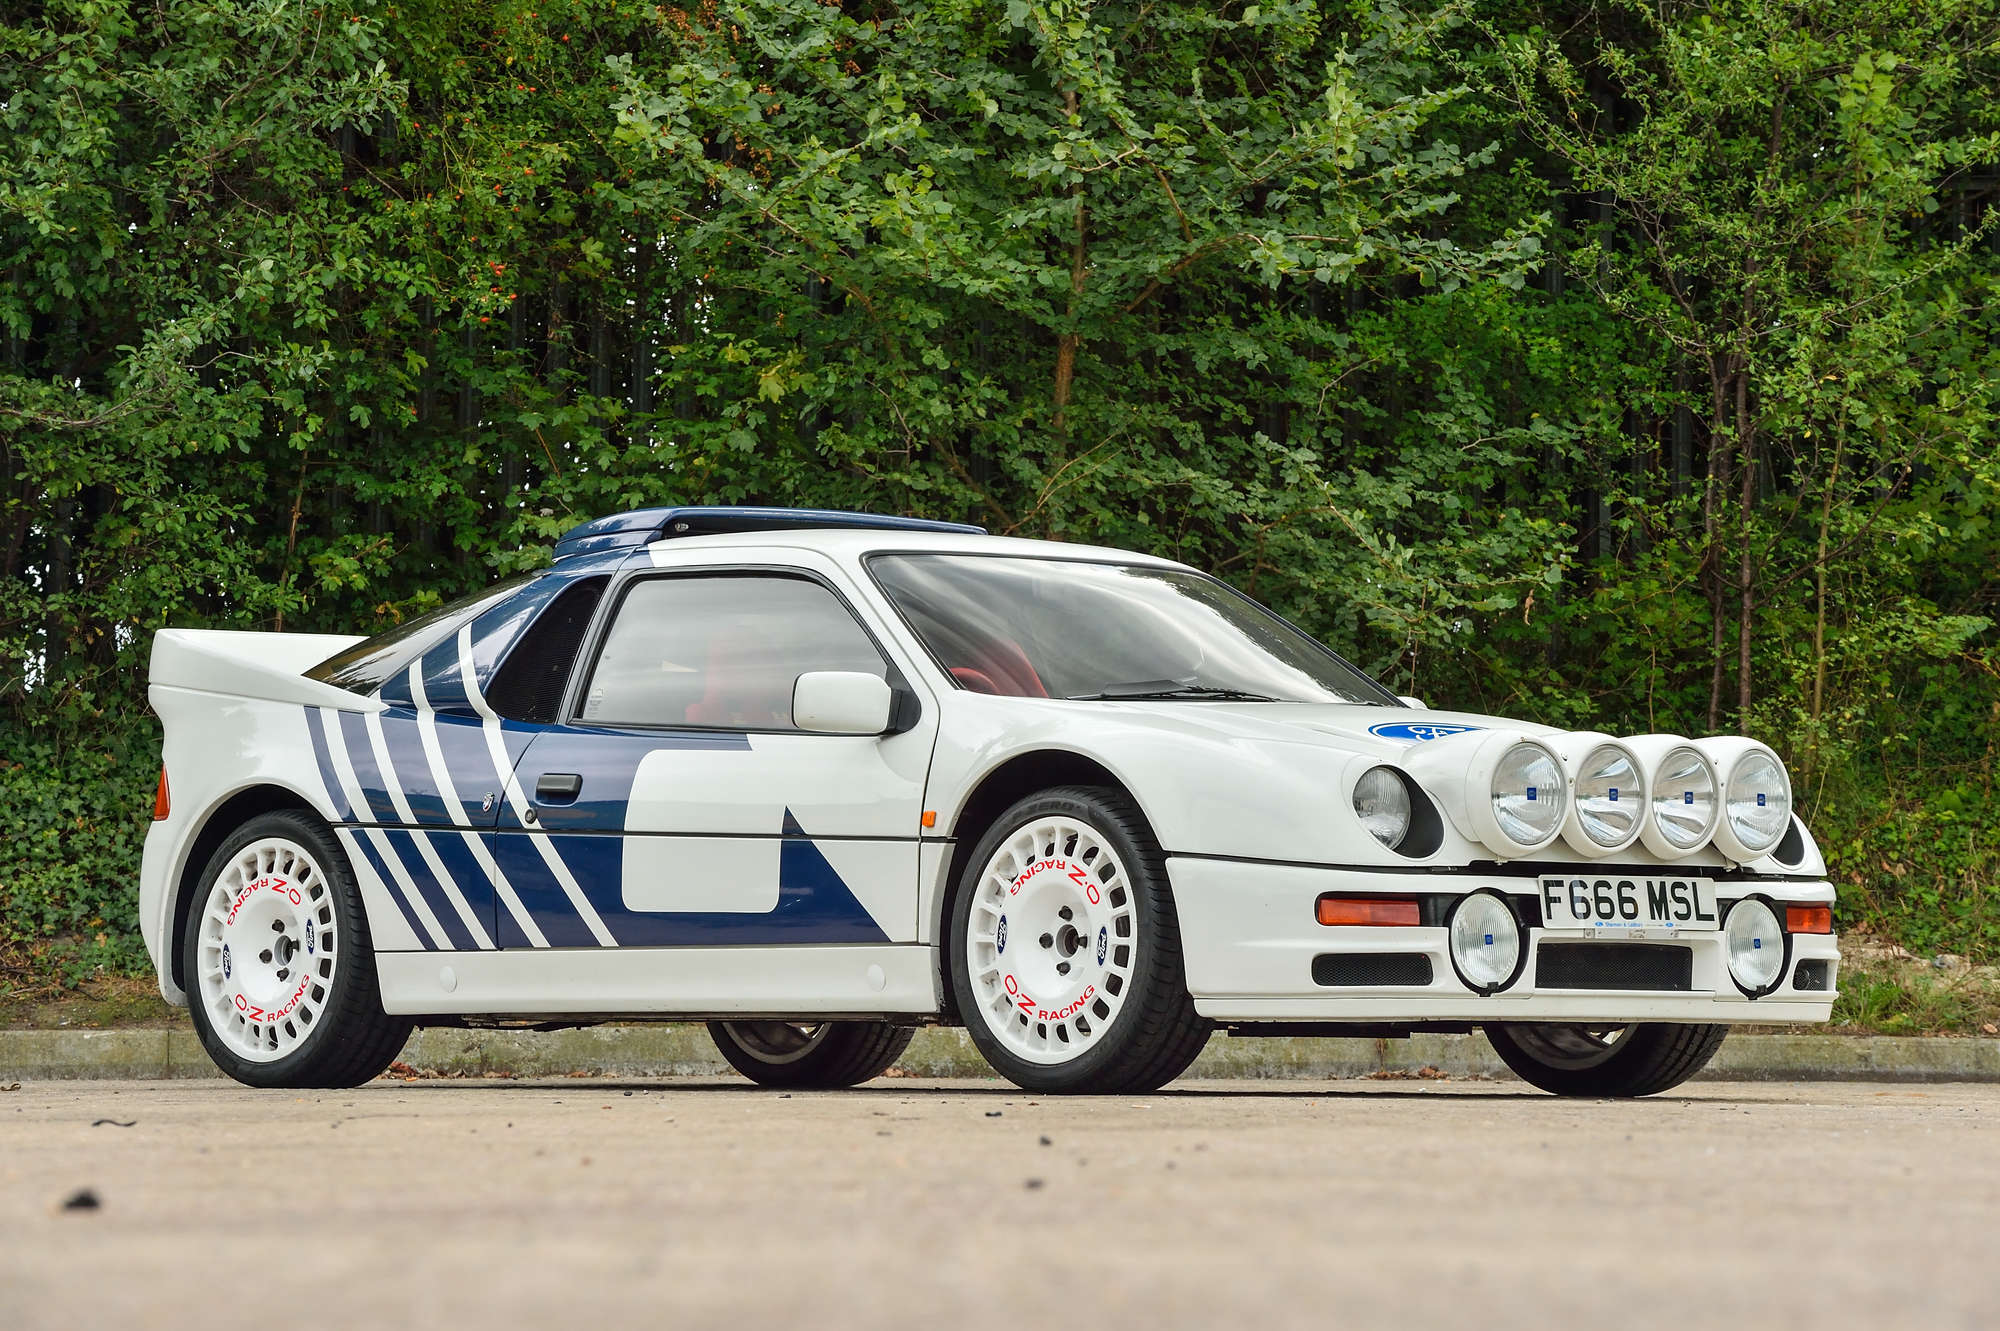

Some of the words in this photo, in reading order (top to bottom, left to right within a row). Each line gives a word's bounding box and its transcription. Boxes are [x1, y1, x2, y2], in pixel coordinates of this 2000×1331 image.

[1009, 860, 1066, 896] RACING
[226, 877, 269, 926] RACING
[1543, 879, 1639, 920] F666
[1646, 880, 1715, 922] MSL
[266, 974, 310, 1022] RACING
[1038, 984, 1096, 1021] RACING
